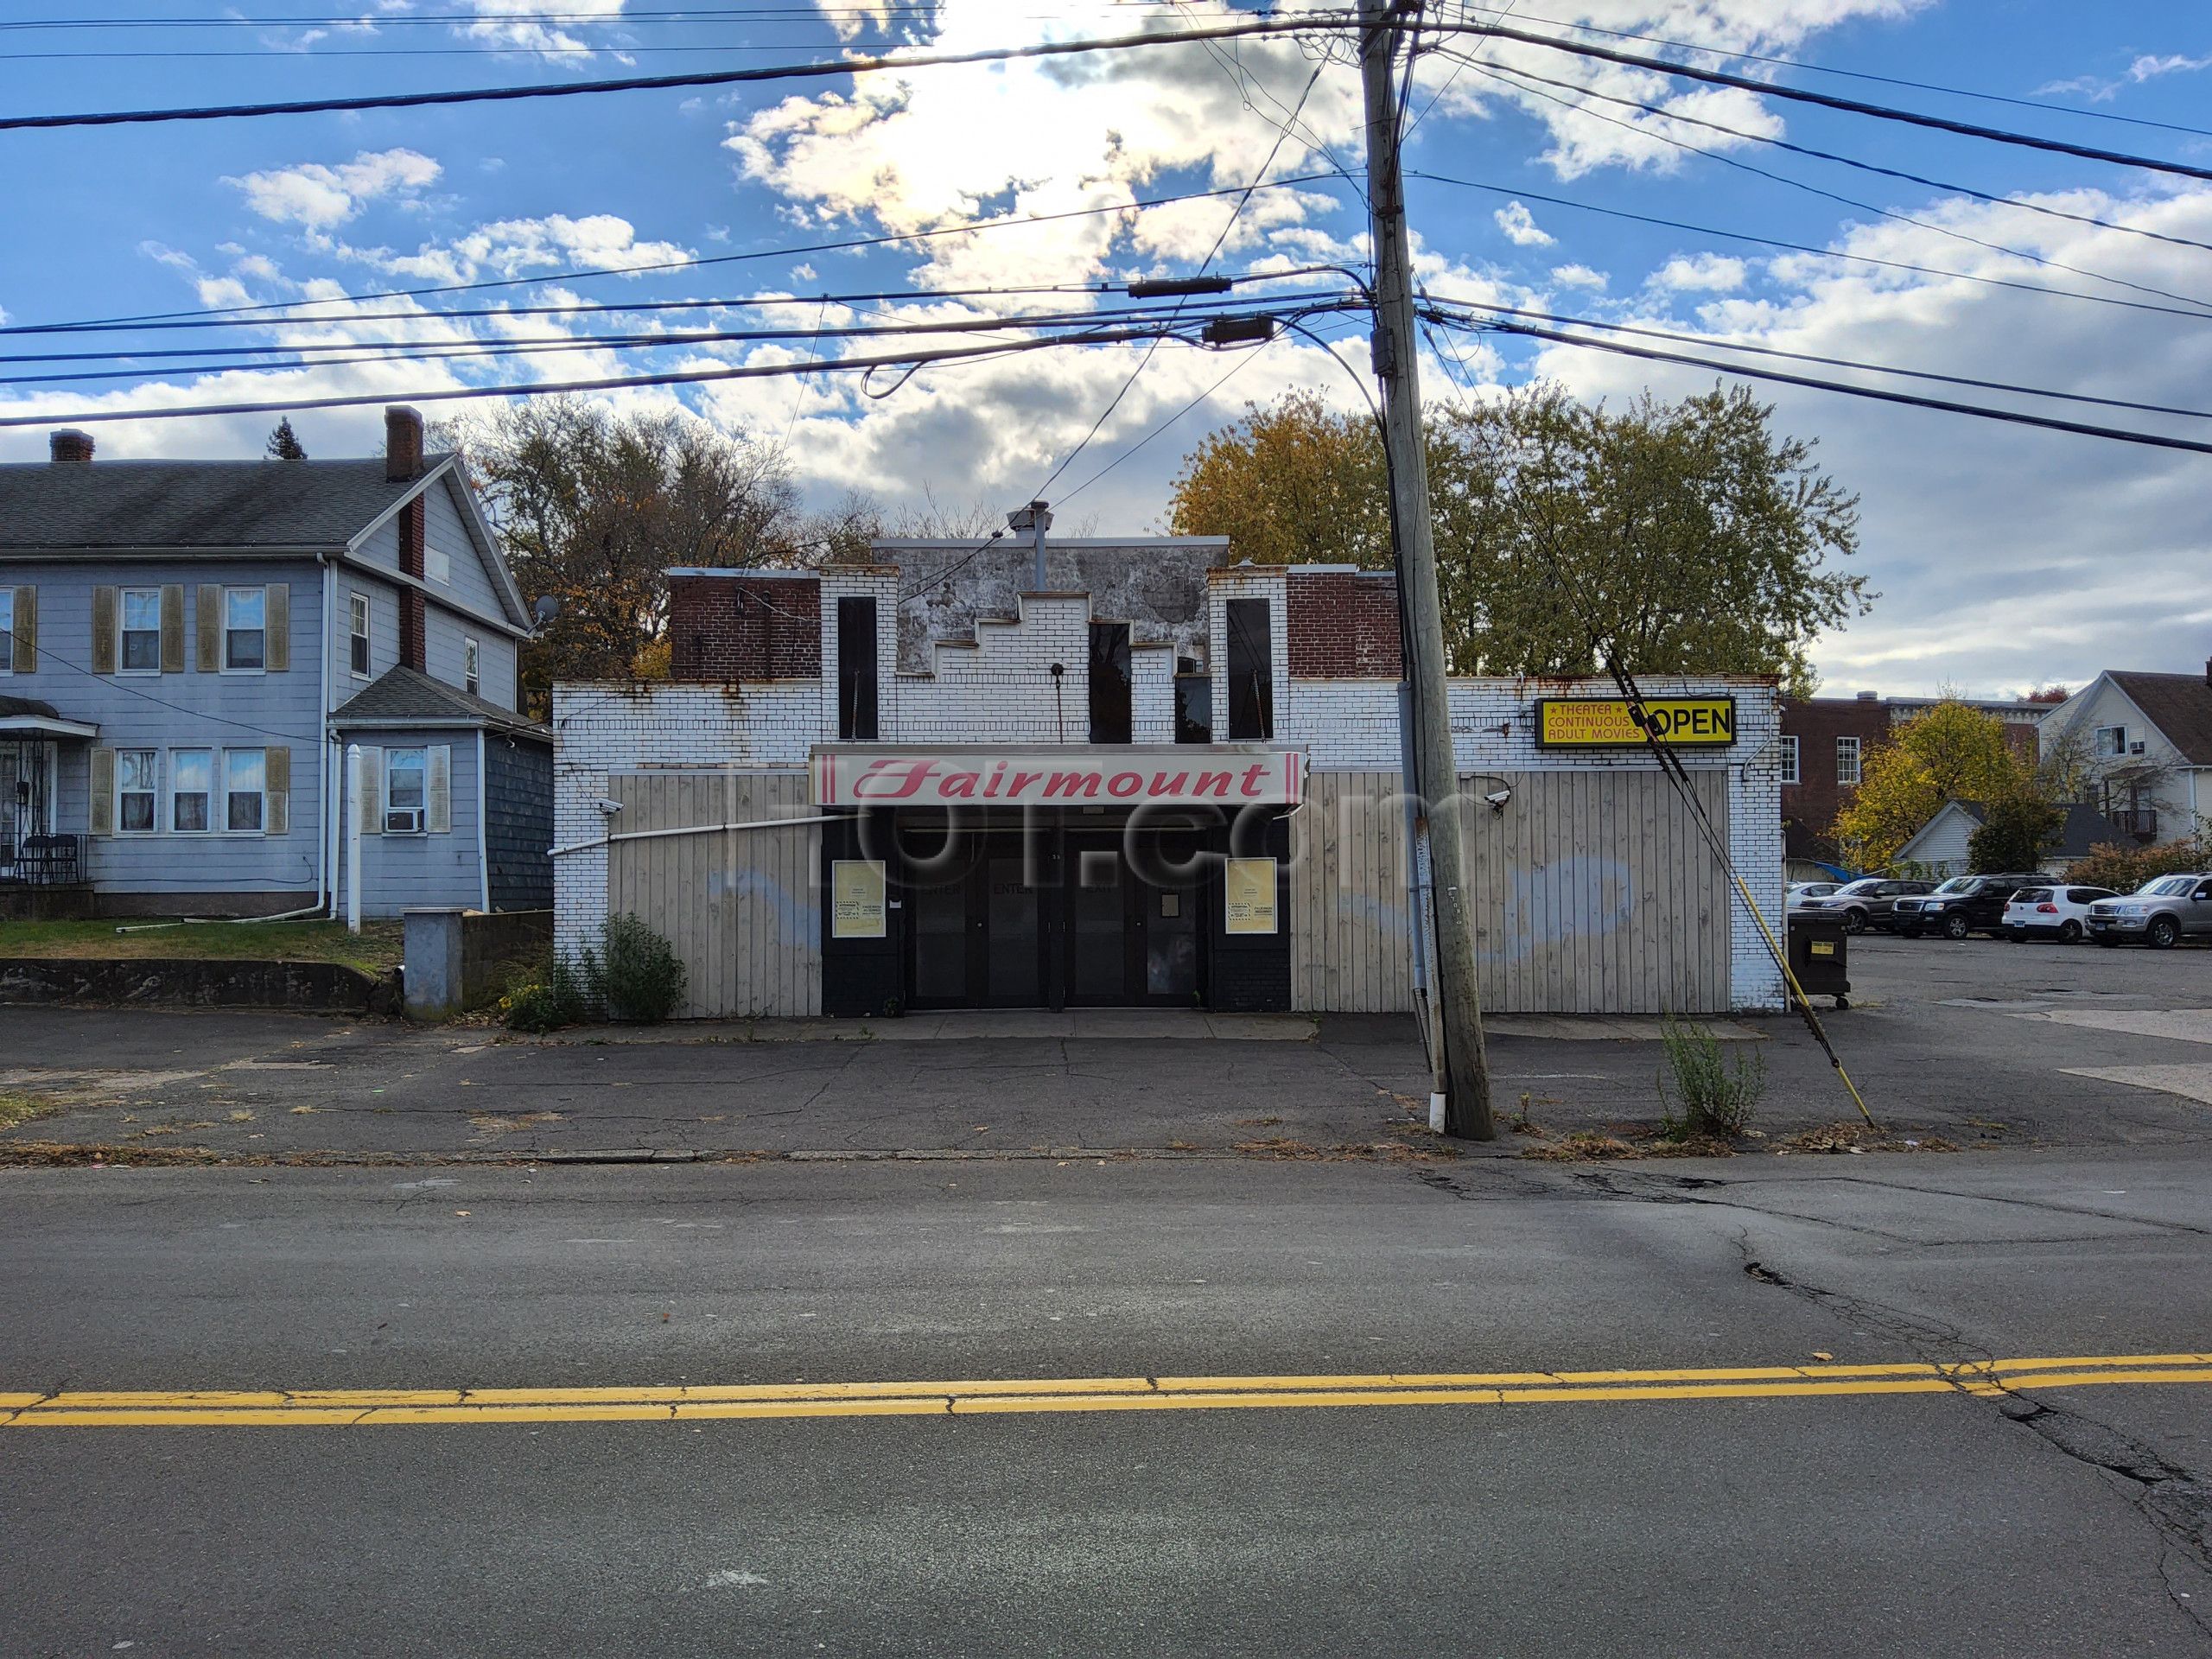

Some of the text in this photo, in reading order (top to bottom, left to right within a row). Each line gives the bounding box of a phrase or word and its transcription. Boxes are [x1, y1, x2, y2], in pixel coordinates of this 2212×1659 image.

[1559, 703, 1612, 715] THEATER
[1548, 716, 1630, 728] CONTINUOUS
[1650, 708, 1732, 734] OPEN
[1548, 728, 1641, 740] ADULT MOVIES
[852, 760, 1272, 798] Fairmount
[993, 883, 1033, 895] ENTER
